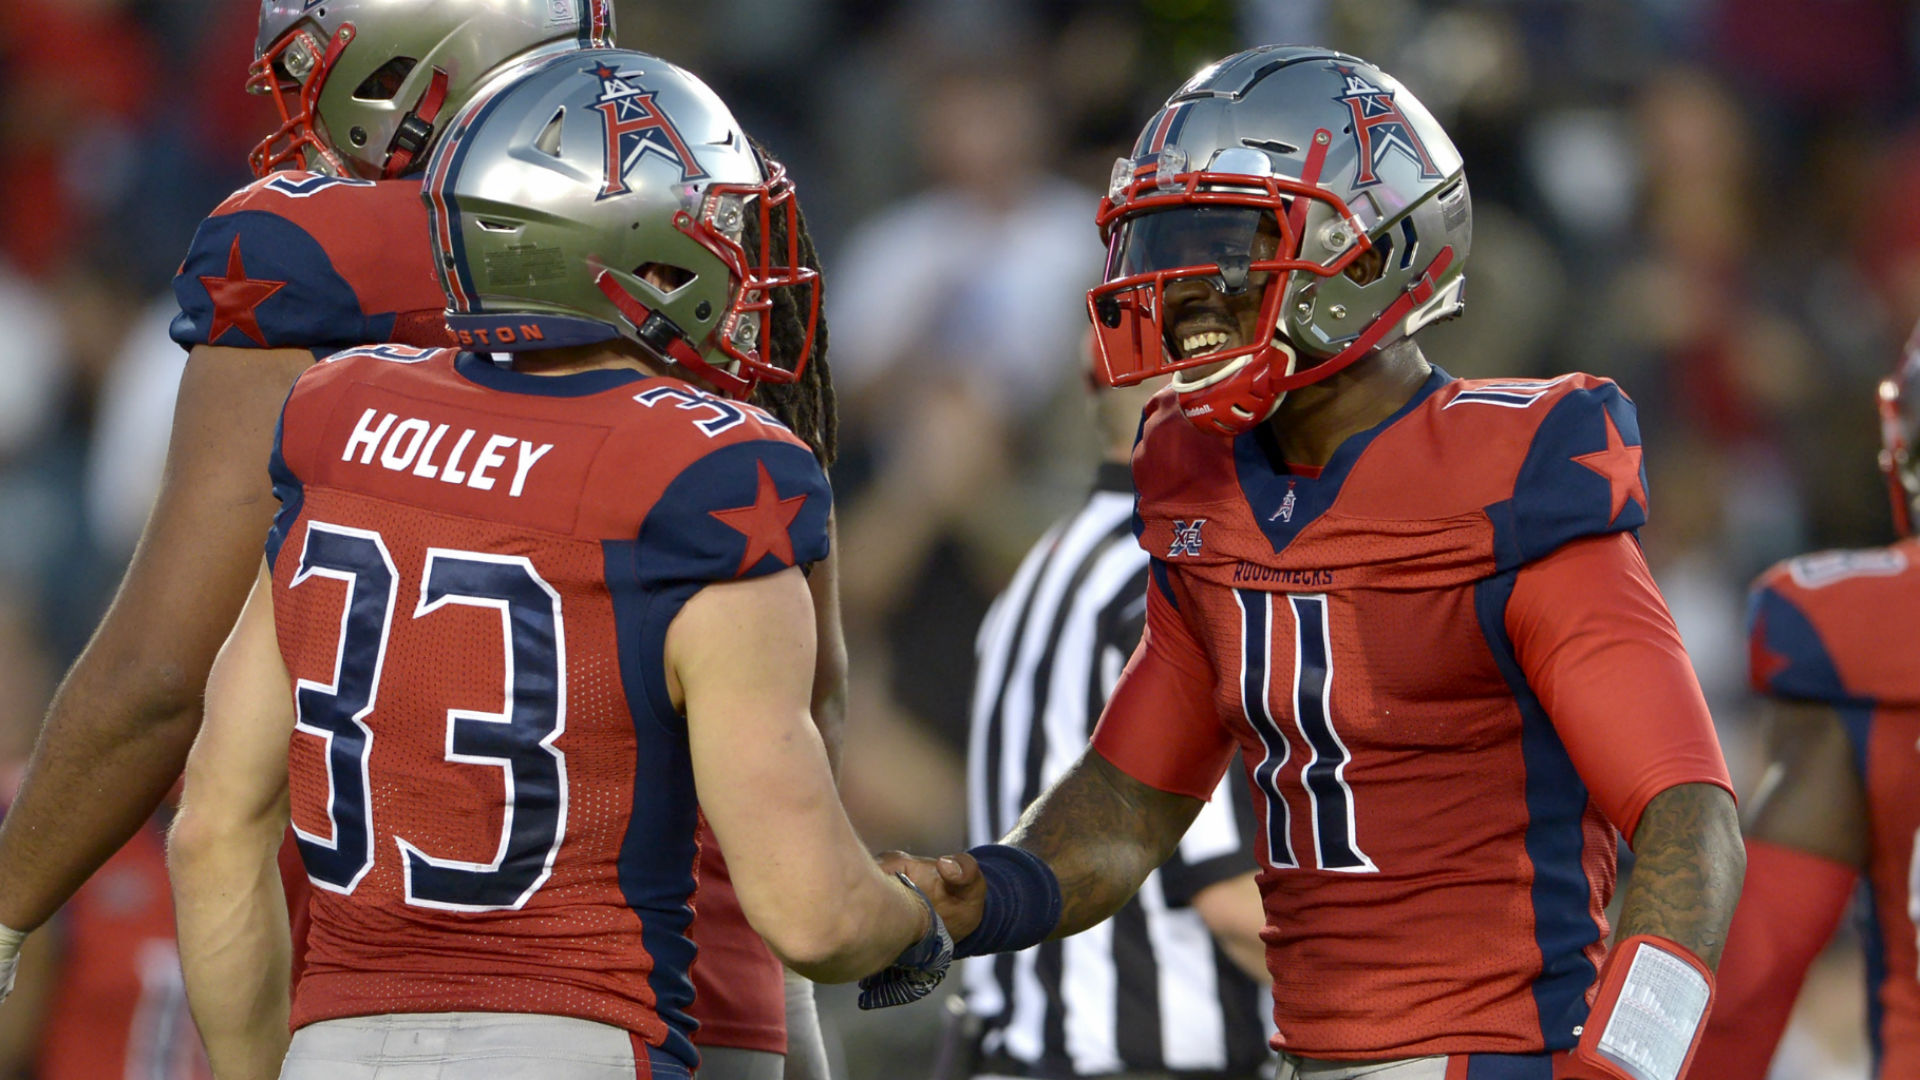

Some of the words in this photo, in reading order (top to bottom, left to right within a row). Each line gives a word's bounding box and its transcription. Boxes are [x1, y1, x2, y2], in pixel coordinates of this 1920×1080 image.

[341, 408, 554, 497] HOLLEY
[290, 520, 569, 911] 33
[1231, 586, 1380, 873] 11
